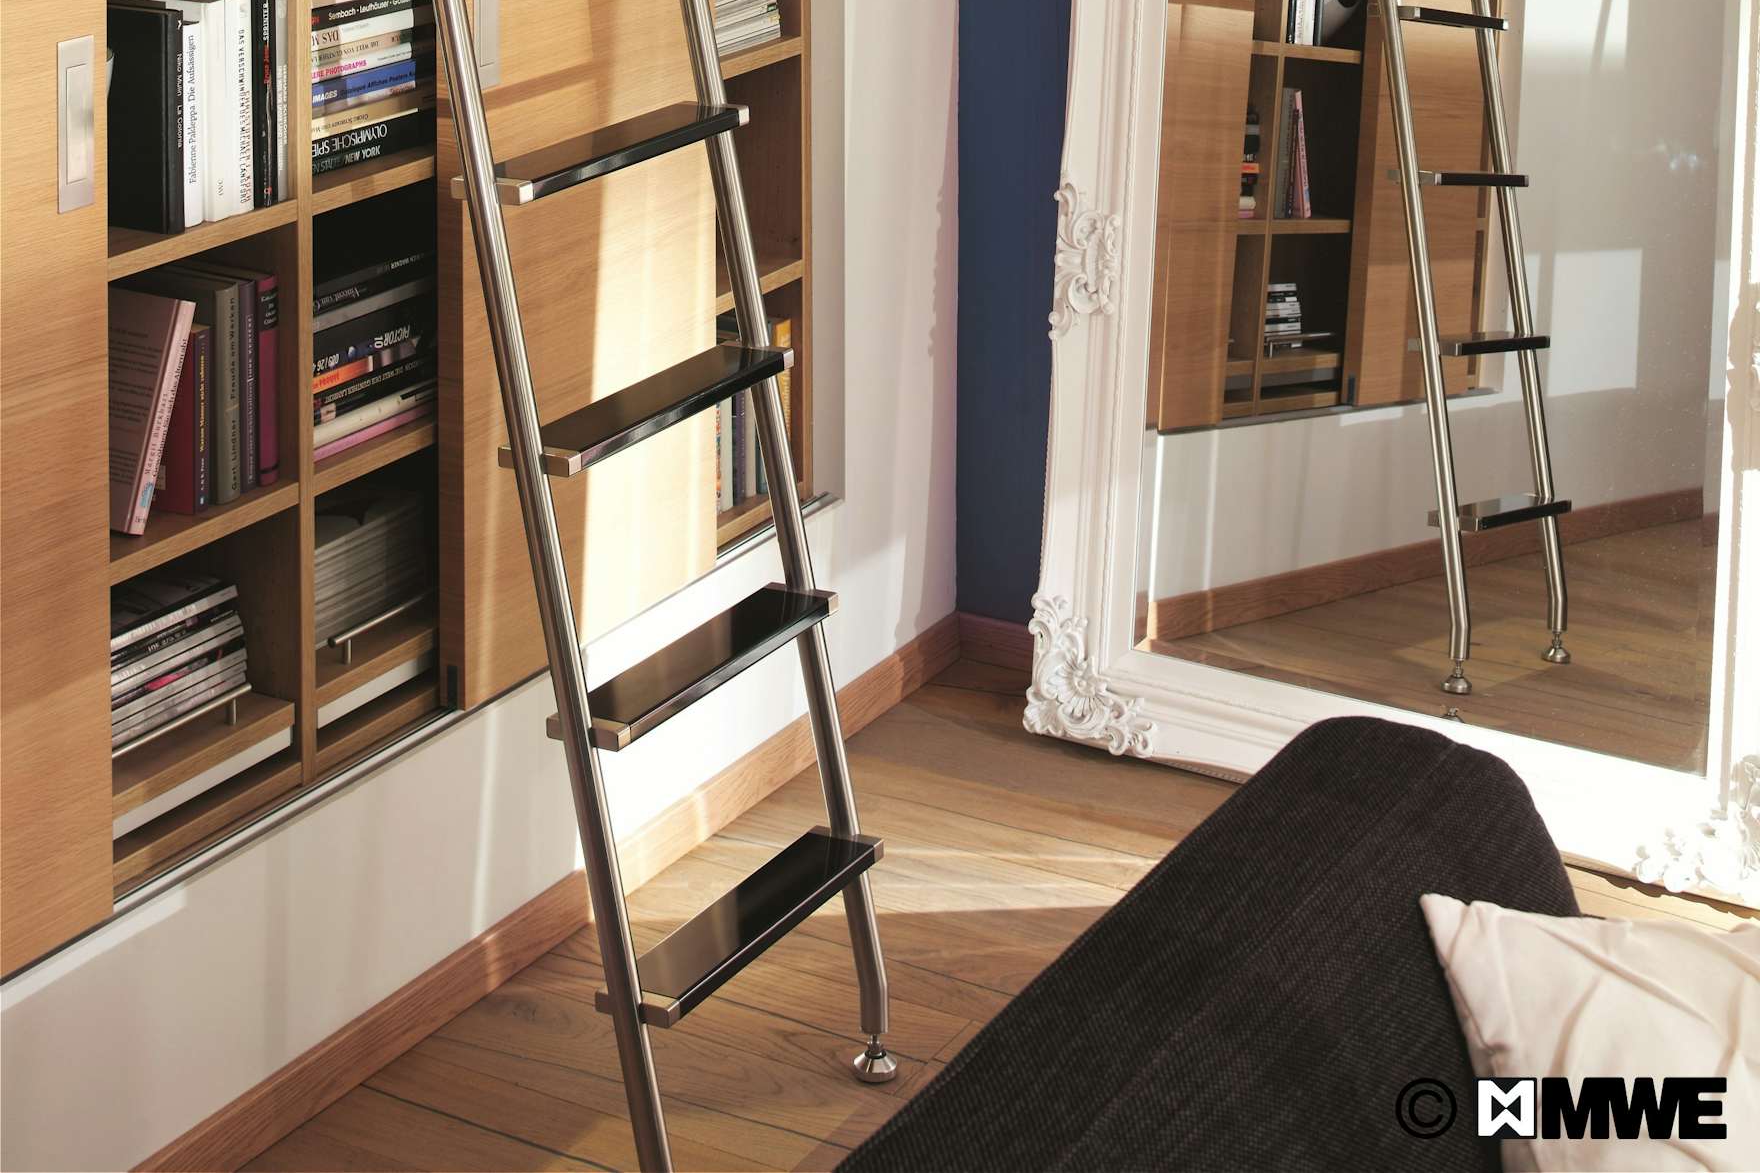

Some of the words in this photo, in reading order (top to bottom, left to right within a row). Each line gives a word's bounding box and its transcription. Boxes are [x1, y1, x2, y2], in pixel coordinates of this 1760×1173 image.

[322, 30, 339, 44] DAS
[325, 59, 367, 75] PHOTOGRAPHS
[187, 87, 195, 102] Die
[312, 89, 338, 103] IMAGES
[330, 123, 388, 153] OLYMPISCHE
[345, 150, 360, 164] NEW
[361, 144, 381, 160] YORK
[188, 145, 197, 184] Fabienne
[373, 336, 383, 349] 10
[383, 325, 410, 347] PICTOR
